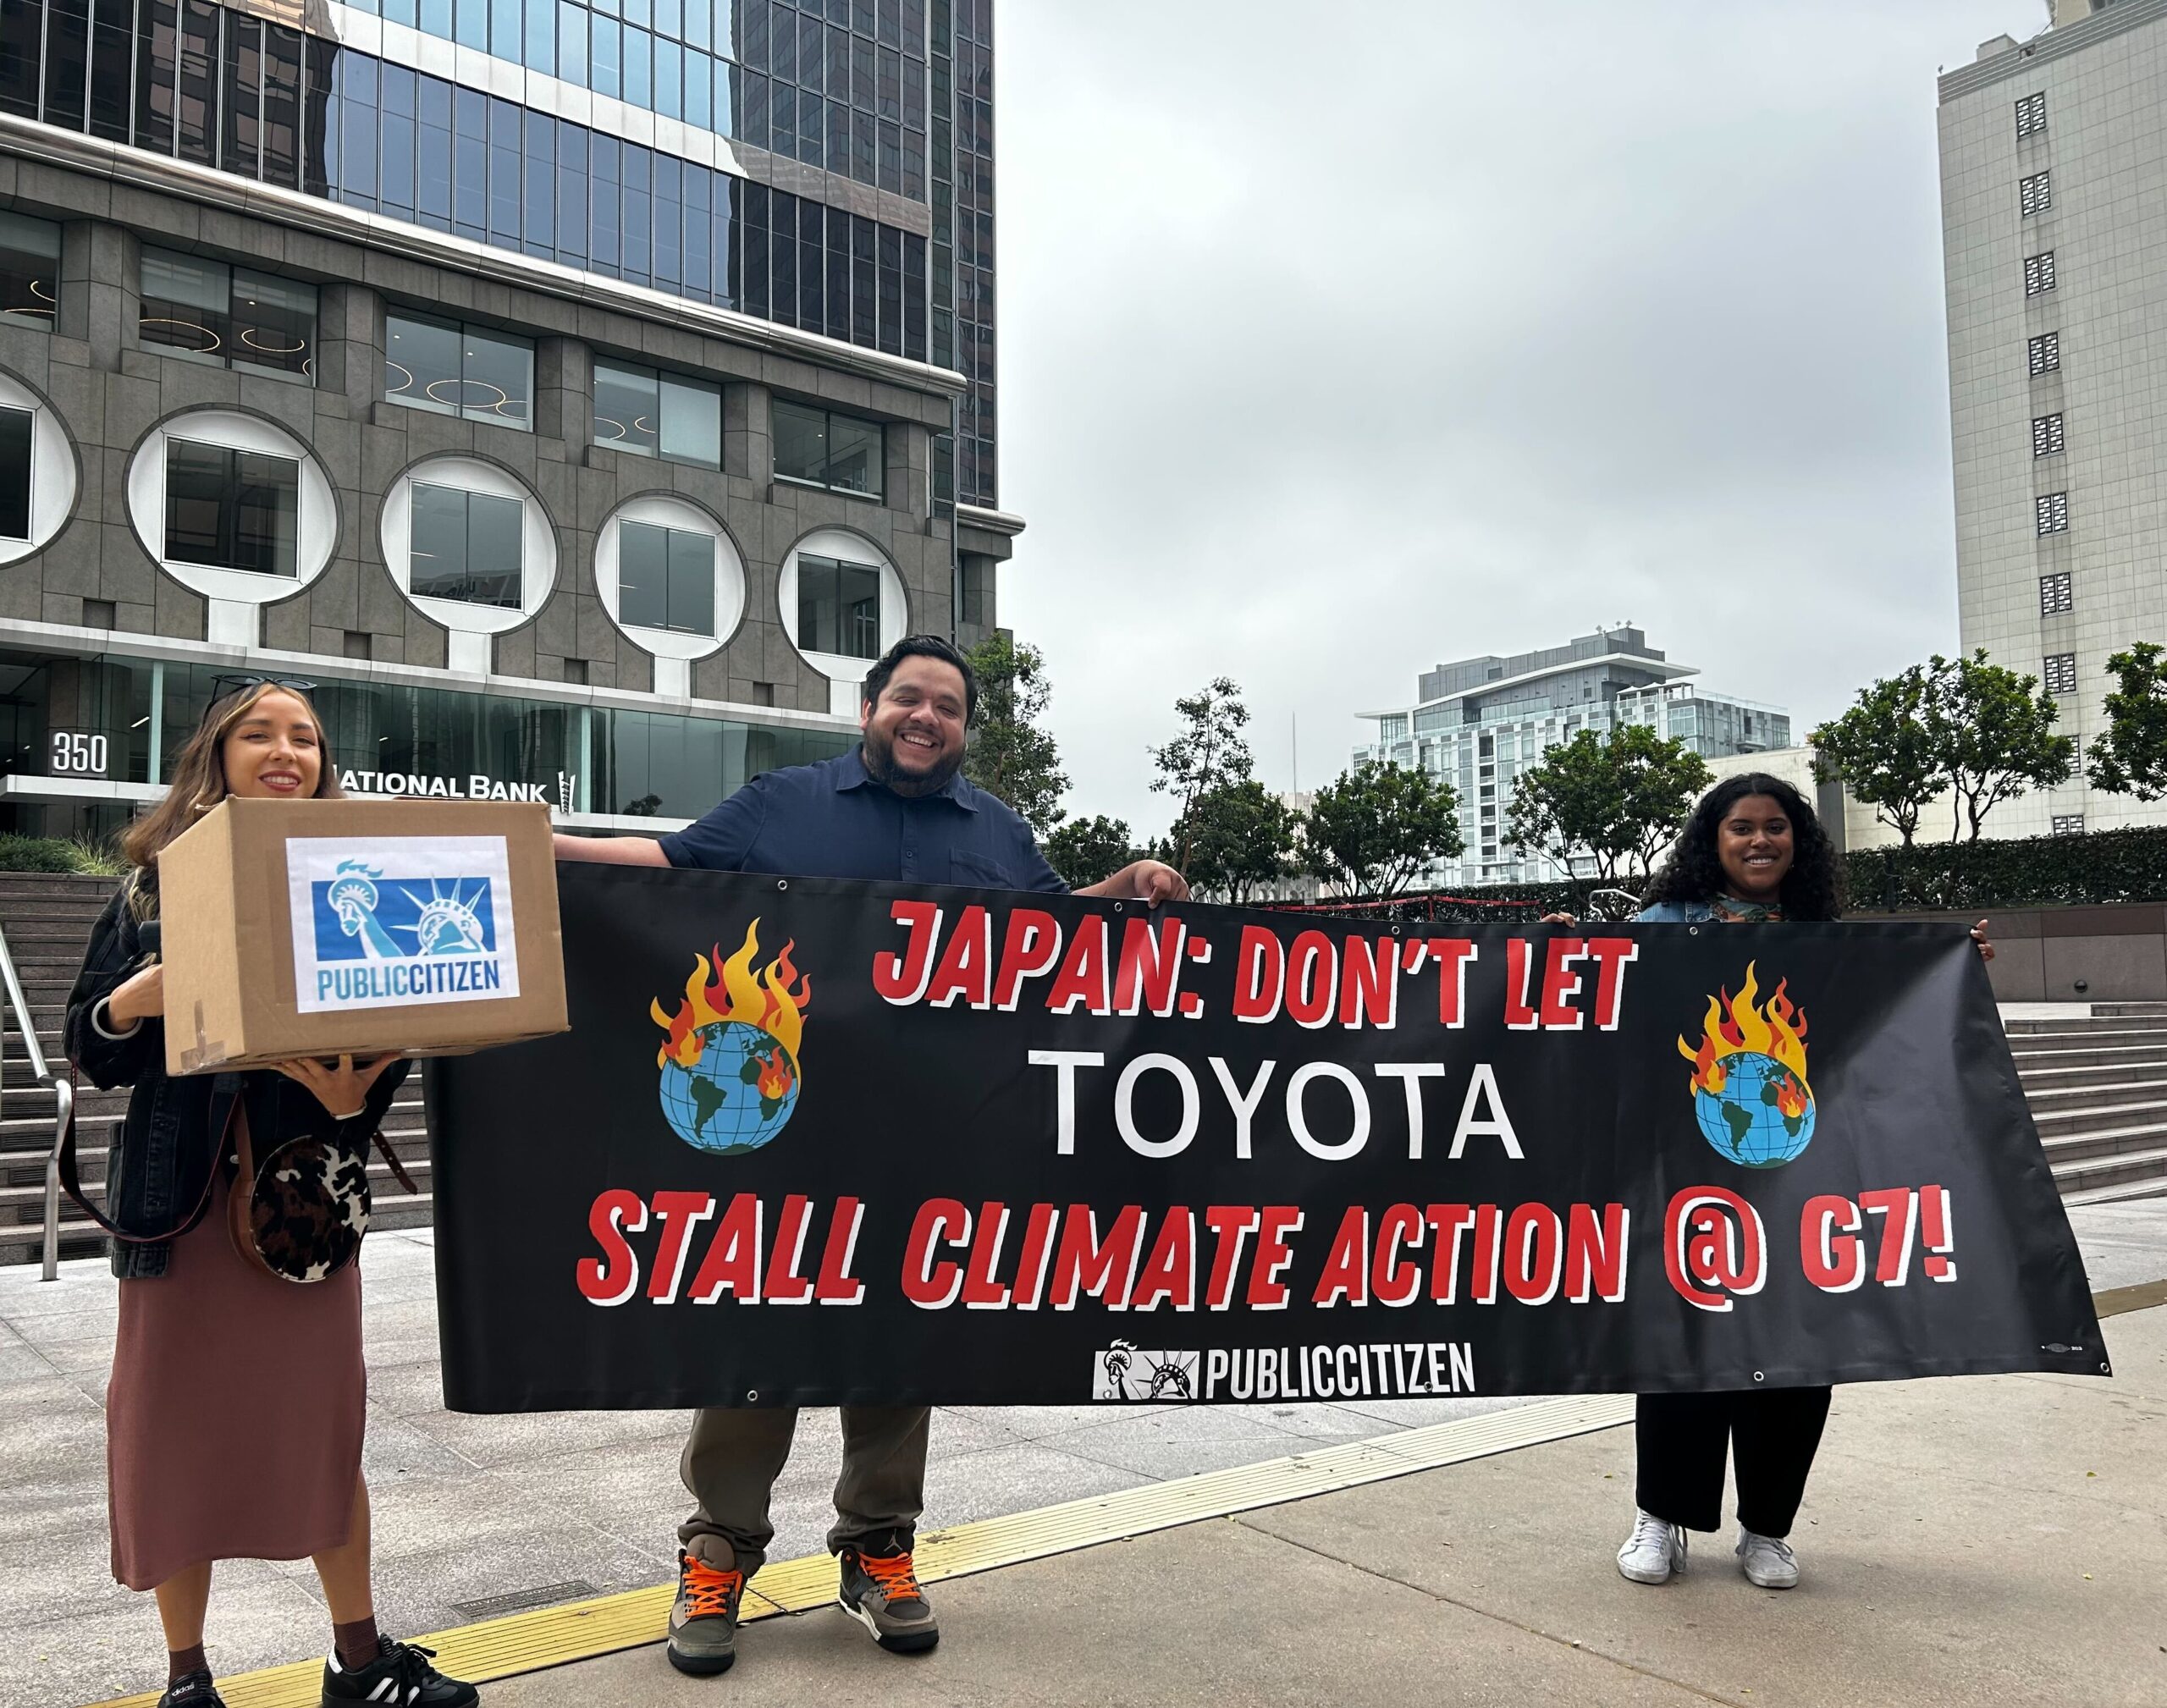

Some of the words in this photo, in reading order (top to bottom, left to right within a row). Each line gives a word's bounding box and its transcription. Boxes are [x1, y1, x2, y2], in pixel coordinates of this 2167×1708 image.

[53, 732, 107, 773] 350
[469, 774, 548, 802] BANK
[317, 960, 499, 1001] PUBLICCITIZEN
[872, 900, 1212, 1019] JAPAN:
[1232, 924, 1478, 1029] DON'T
[1504, 937, 1639, 1031] LET
[1028, 1050, 1525, 1160] TOYOTA
[576, 1189, 866, 1306] STALL
[901, 1198, 1304, 1311] CLIMATE
[1311, 1203, 1630, 1309] ACTION
[1664, 1185, 1767, 1312] @
[1800, 1184, 1957, 1293] G7!
[1205, 1342, 1475, 1399] PUBLICCITIZEN
